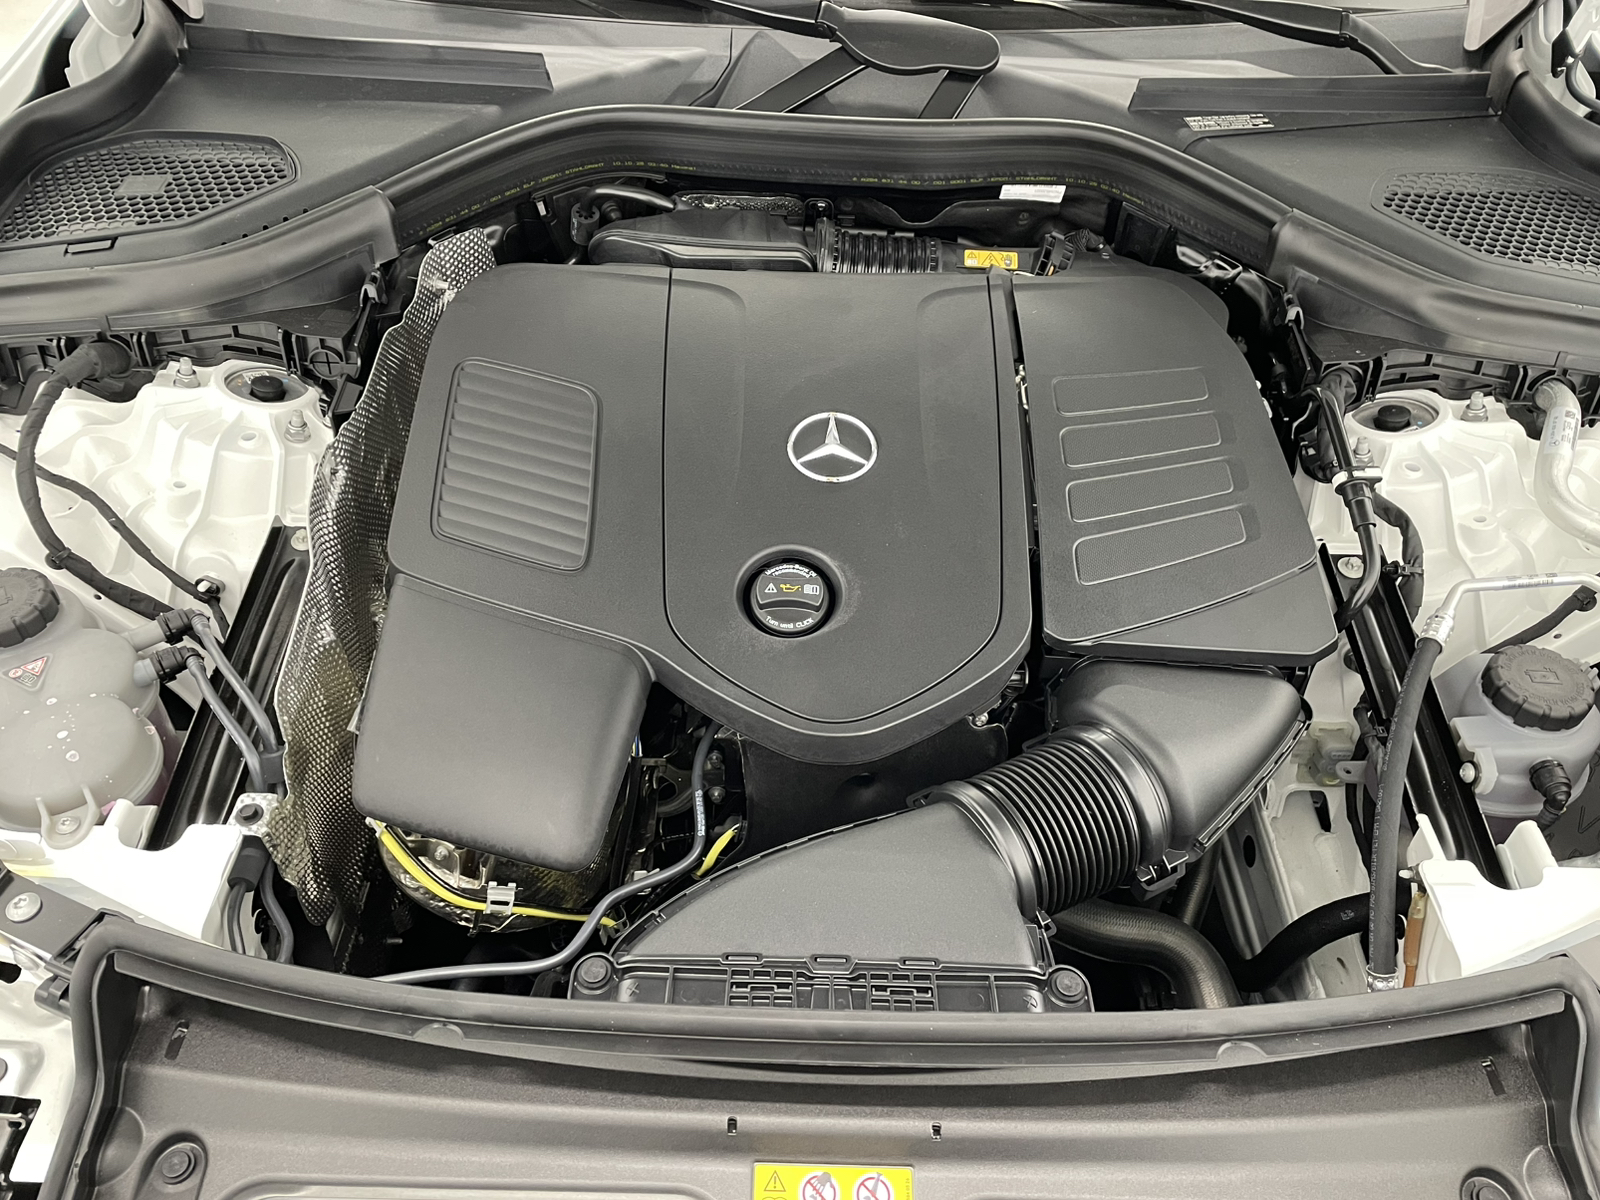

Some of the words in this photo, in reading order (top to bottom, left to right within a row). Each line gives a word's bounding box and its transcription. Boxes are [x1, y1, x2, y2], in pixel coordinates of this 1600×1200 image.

[764, 564, 810, 576] Mercedes-Benz
[765, 615, 779, 626] Turn
[796, 617, 814, 628] CLICK
